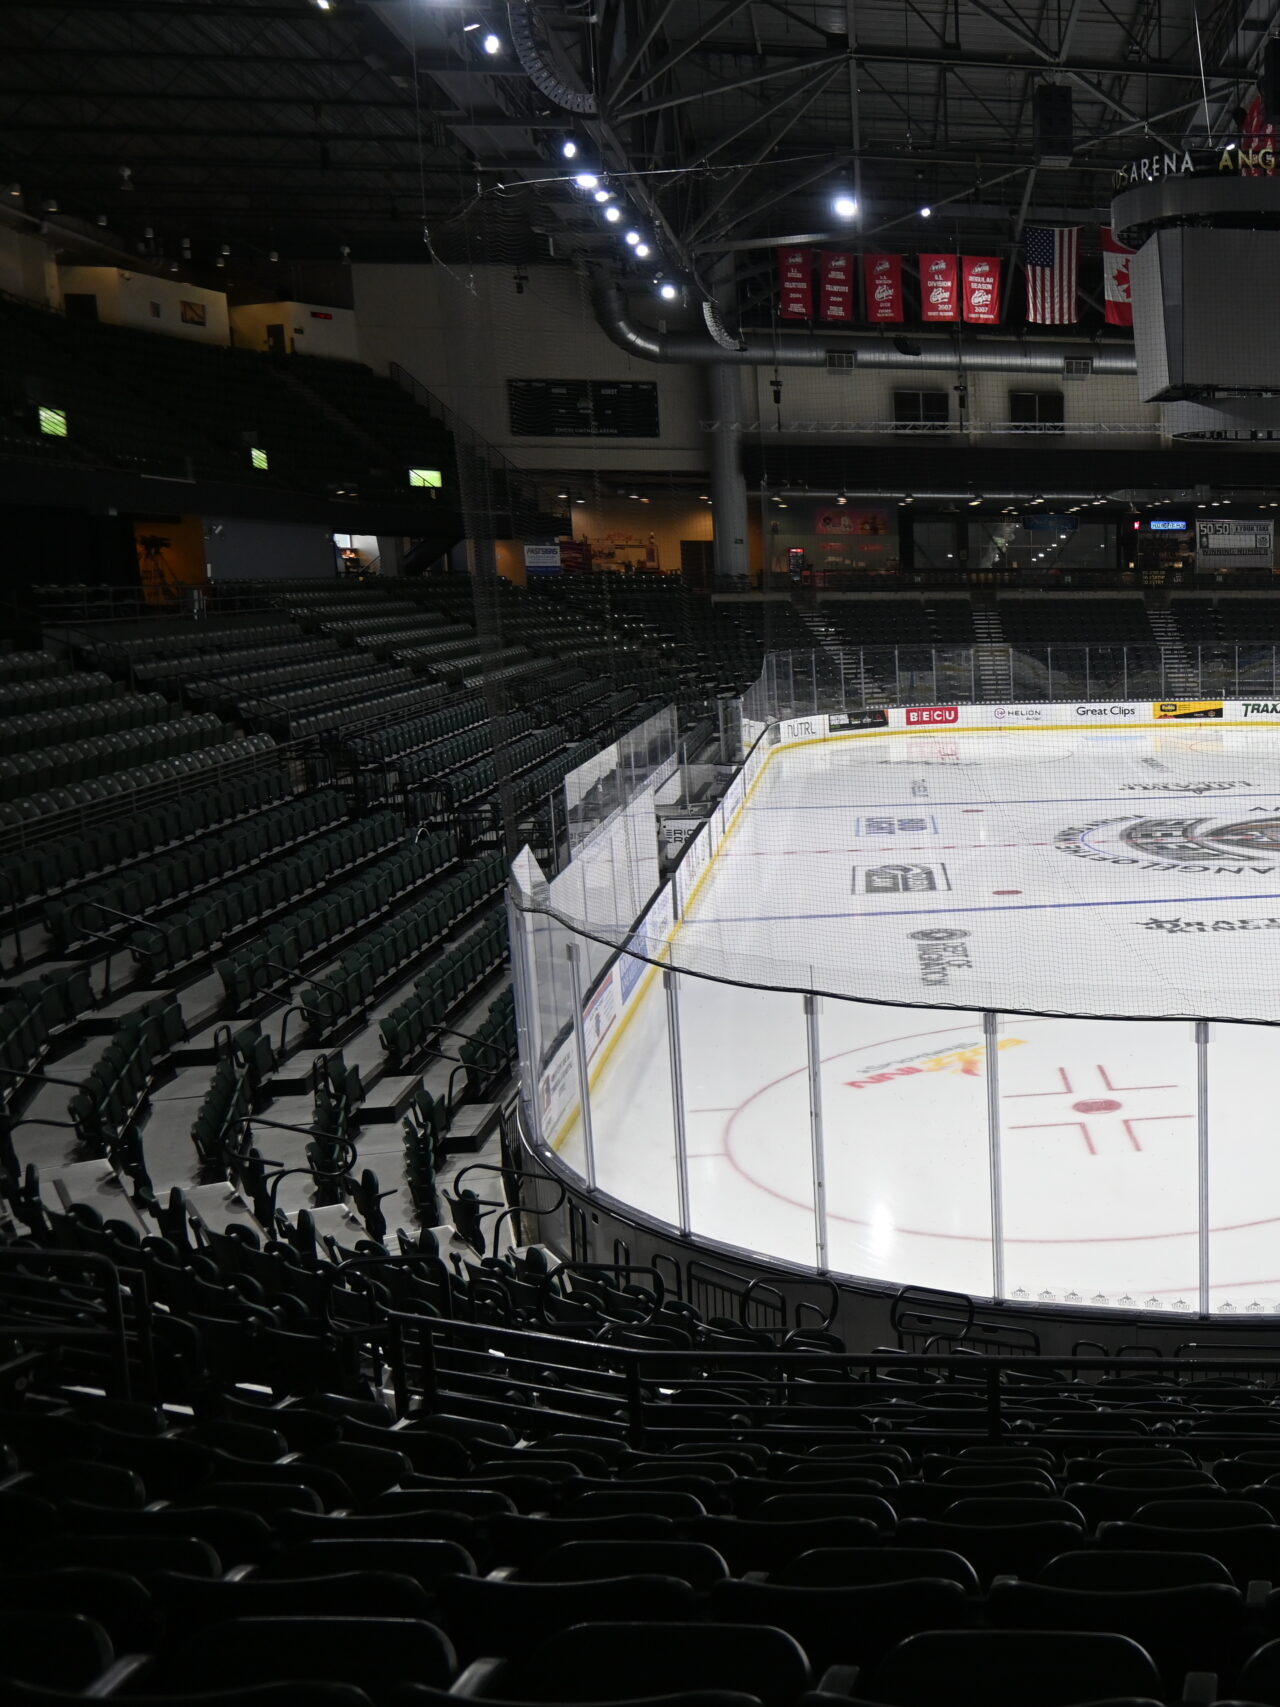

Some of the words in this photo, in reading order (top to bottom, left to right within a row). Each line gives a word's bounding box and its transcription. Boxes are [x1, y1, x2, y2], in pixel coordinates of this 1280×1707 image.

[1129, 151, 1195, 184] ARENA
[1076, 706, 1107, 716] Great
[1110, 706, 1135, 717] Clips
